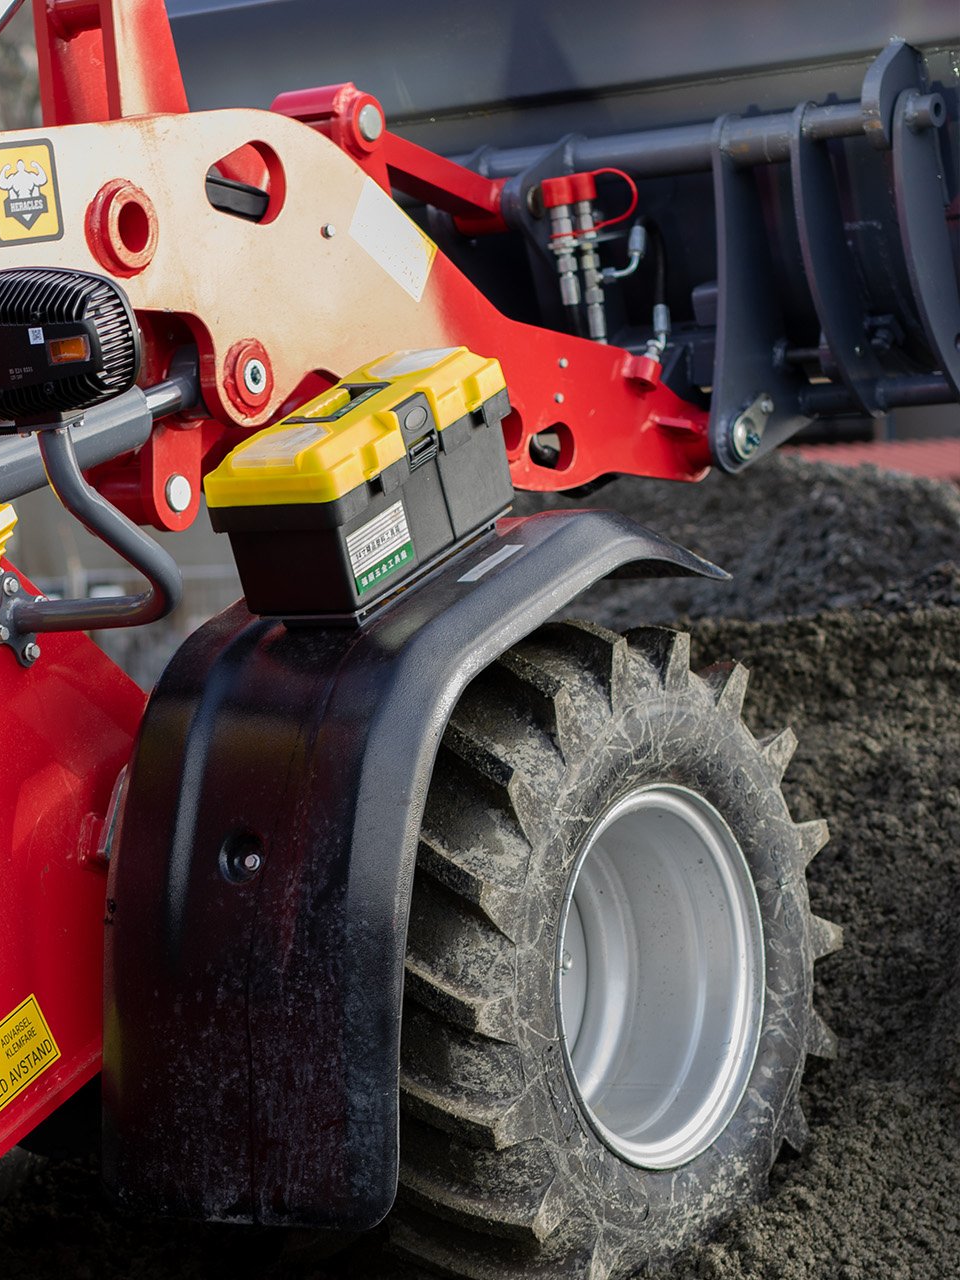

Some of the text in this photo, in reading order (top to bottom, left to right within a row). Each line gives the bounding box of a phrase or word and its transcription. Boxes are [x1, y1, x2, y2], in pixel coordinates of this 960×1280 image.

[10, 199, 44, 212] HERACLES
[0, 1016, 32, 1049] ADVARSEL
[4, 1026, 38, 1060] KLEMFARE
[8, 1039, 53, 1086] AVSTAND
